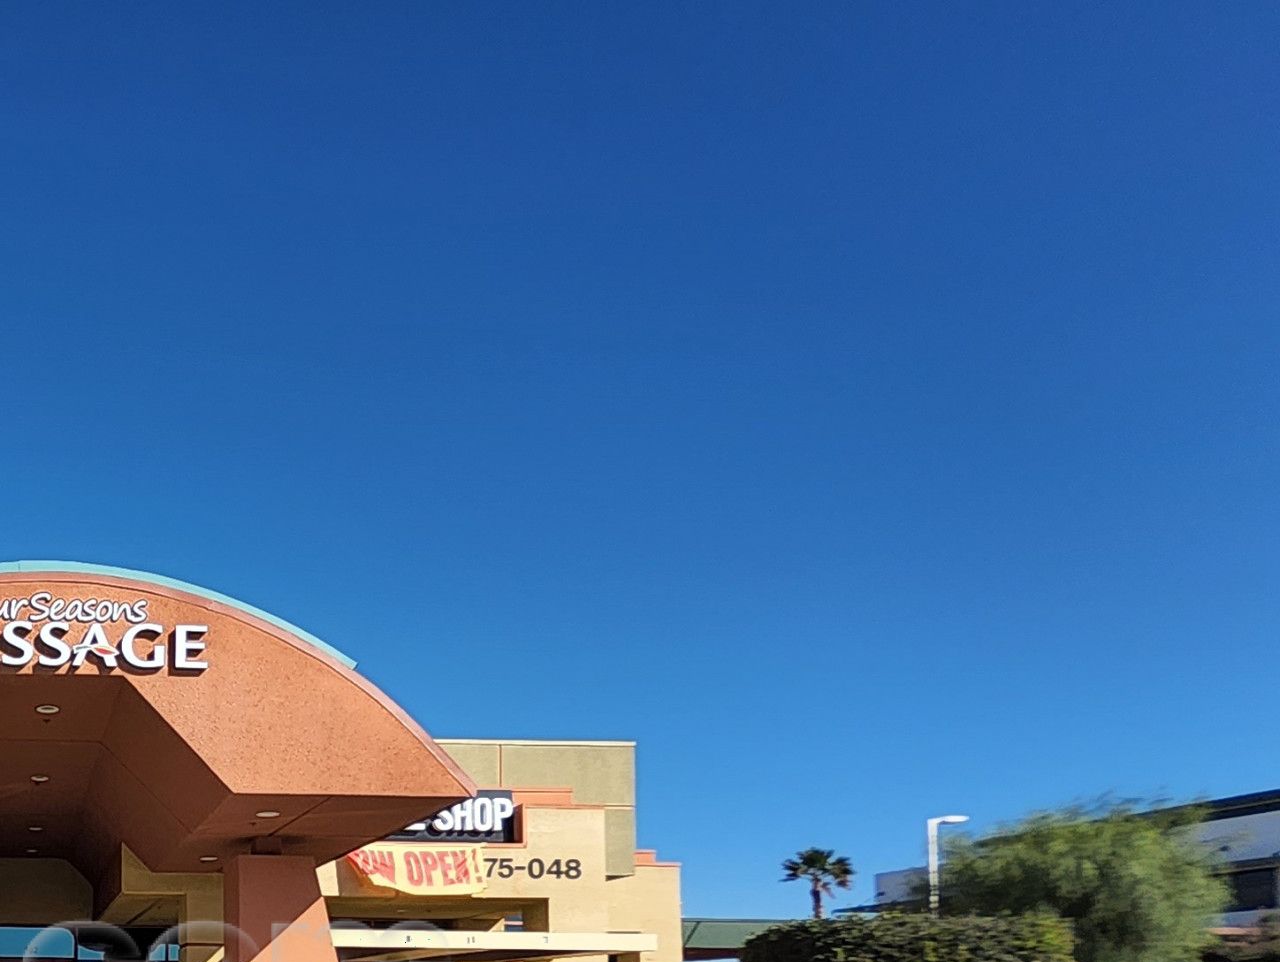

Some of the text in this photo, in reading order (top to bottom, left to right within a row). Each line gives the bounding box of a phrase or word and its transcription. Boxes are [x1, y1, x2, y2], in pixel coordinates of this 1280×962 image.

[30, 591, 149, 622] Seasons
[432, 797, 513, 832] SHOP
[348, 848, 483, 887] OW OPEN!
[483, 857, 582, 880] 75-048
